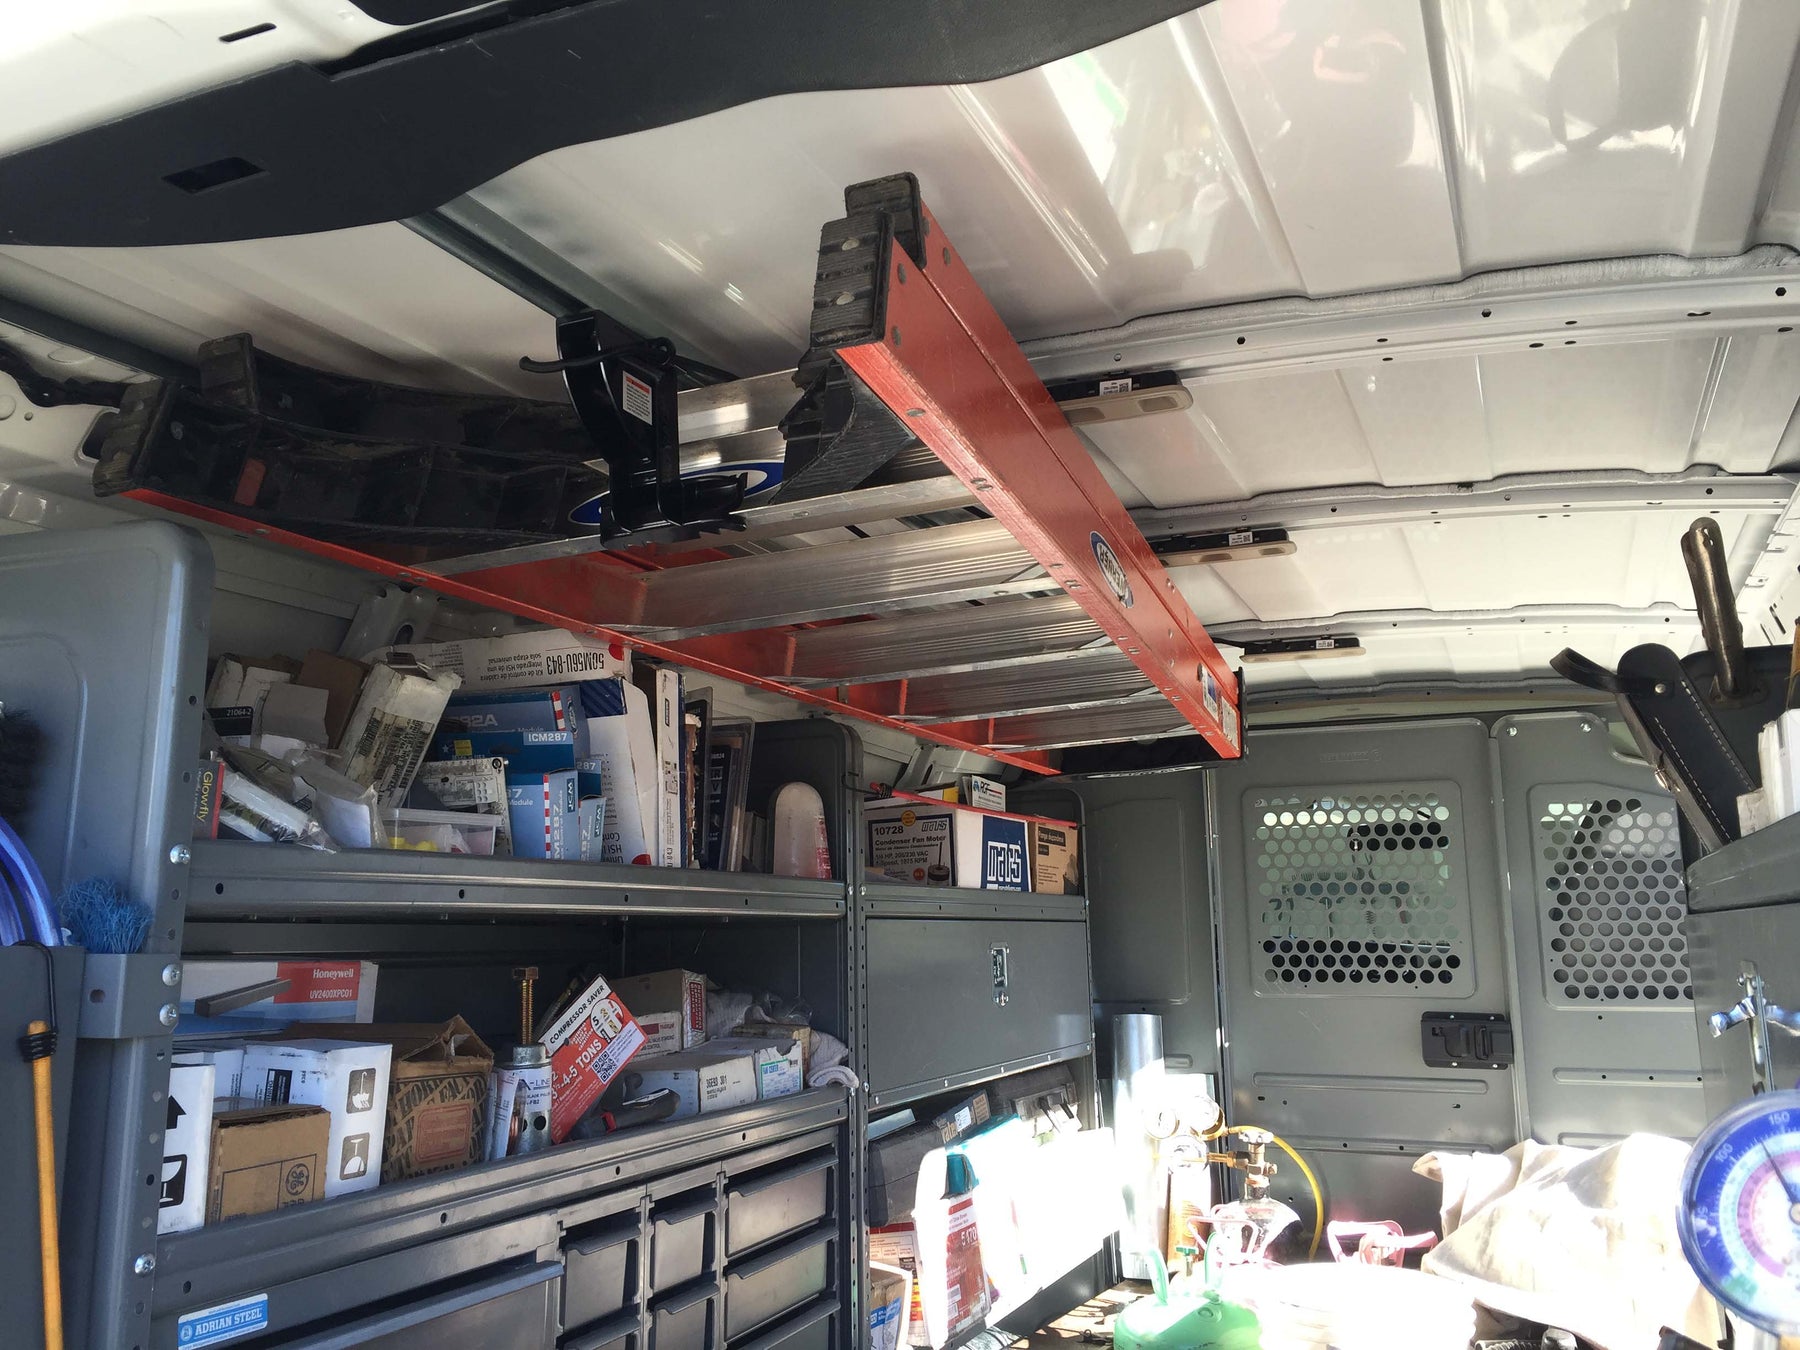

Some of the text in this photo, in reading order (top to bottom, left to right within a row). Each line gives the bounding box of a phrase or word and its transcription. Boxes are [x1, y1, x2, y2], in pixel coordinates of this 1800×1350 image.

[488, 652, 542, 665] sola etapa universal
[516, 660, 543, 670] integrado
[480, 674, 500, 682] caldera
[508, 671, 527, 680] control
[528, 732, 568, 743] ICM287
[196, 770, 214, 824] Glowfly
[874, 825, 904, 836] 10728
[875, 838, 911, 846] Condenser
[313, 968, 354, 980] Honeywell
[549, 1003, 588, 1044] COMPRESSOR
[586, 984, 605, 1005] SAVER
[592, 1016, 600, 1026] 5
[576, 1038, 602, 1069] TONS
[1767, 1110, 1791, 1125] 150
[1714, 1143, 1733, 1162] 100
[195, 1307, 264, 1336] ADRIAN STEEL
